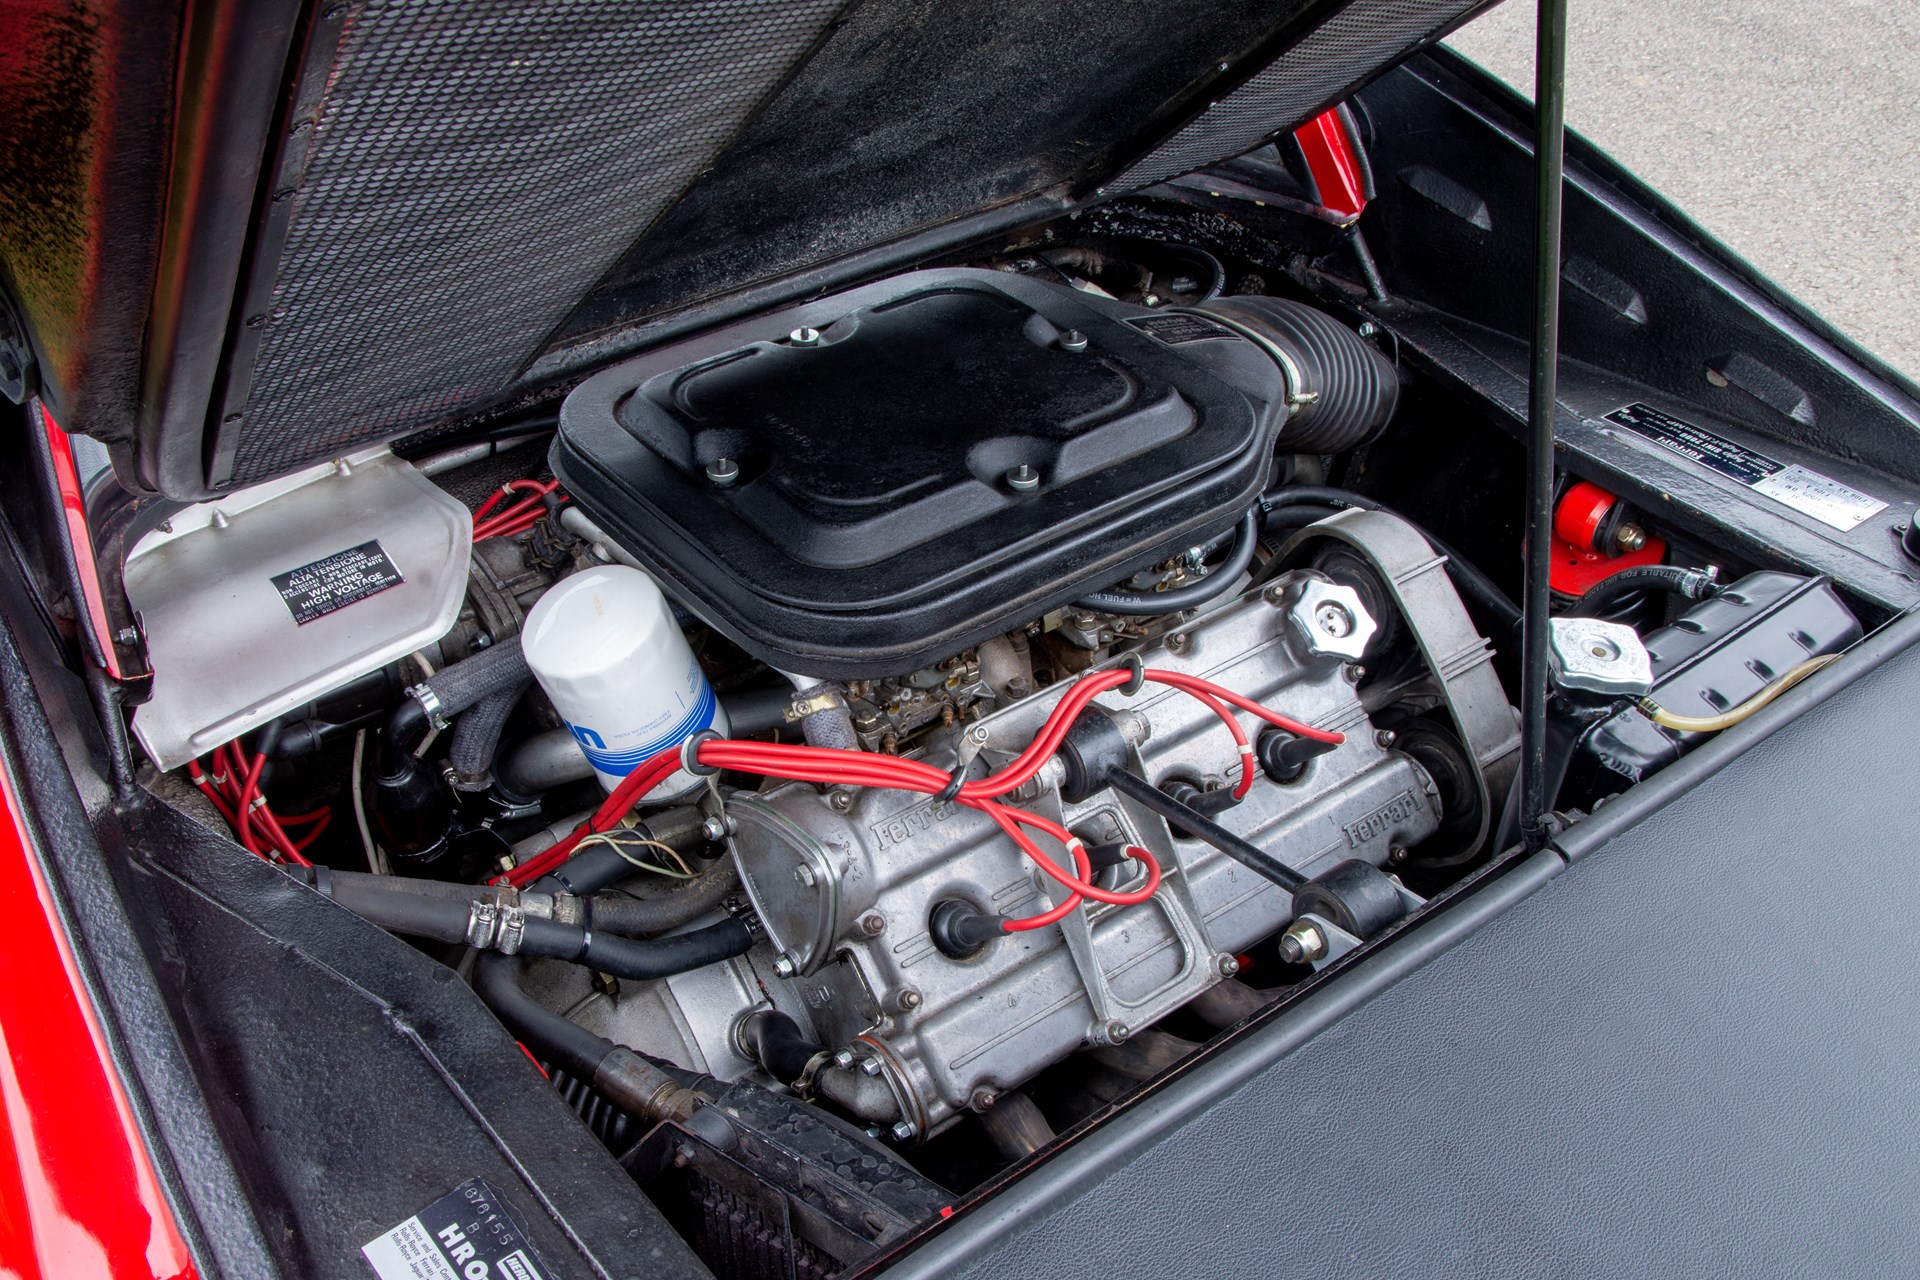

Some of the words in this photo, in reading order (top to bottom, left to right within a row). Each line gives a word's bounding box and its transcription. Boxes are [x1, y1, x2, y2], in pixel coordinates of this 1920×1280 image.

[289, 573, 314, 587] ALTA
[315, 552, 366, 577] TENSIONE
[291, 549, 359, 579] ATTENZIONE
[300, 593, 332, 610] HIGH
[334, 571, 384, 597] VOLTAGE
[308, 571, 364, 598] WARNING
[1343, 786, 1423, 849] Ferrari
[408, 1221, 423, 1241] Service
[421, 1242, 433, 1254] and
[429, 1253, 441, 1269] Sales
[438, 1222, 489, 1280] HRO
[410, 1262, 425, 1279] Jaguar
[420, 1257, 437, 1276] Ferrari
